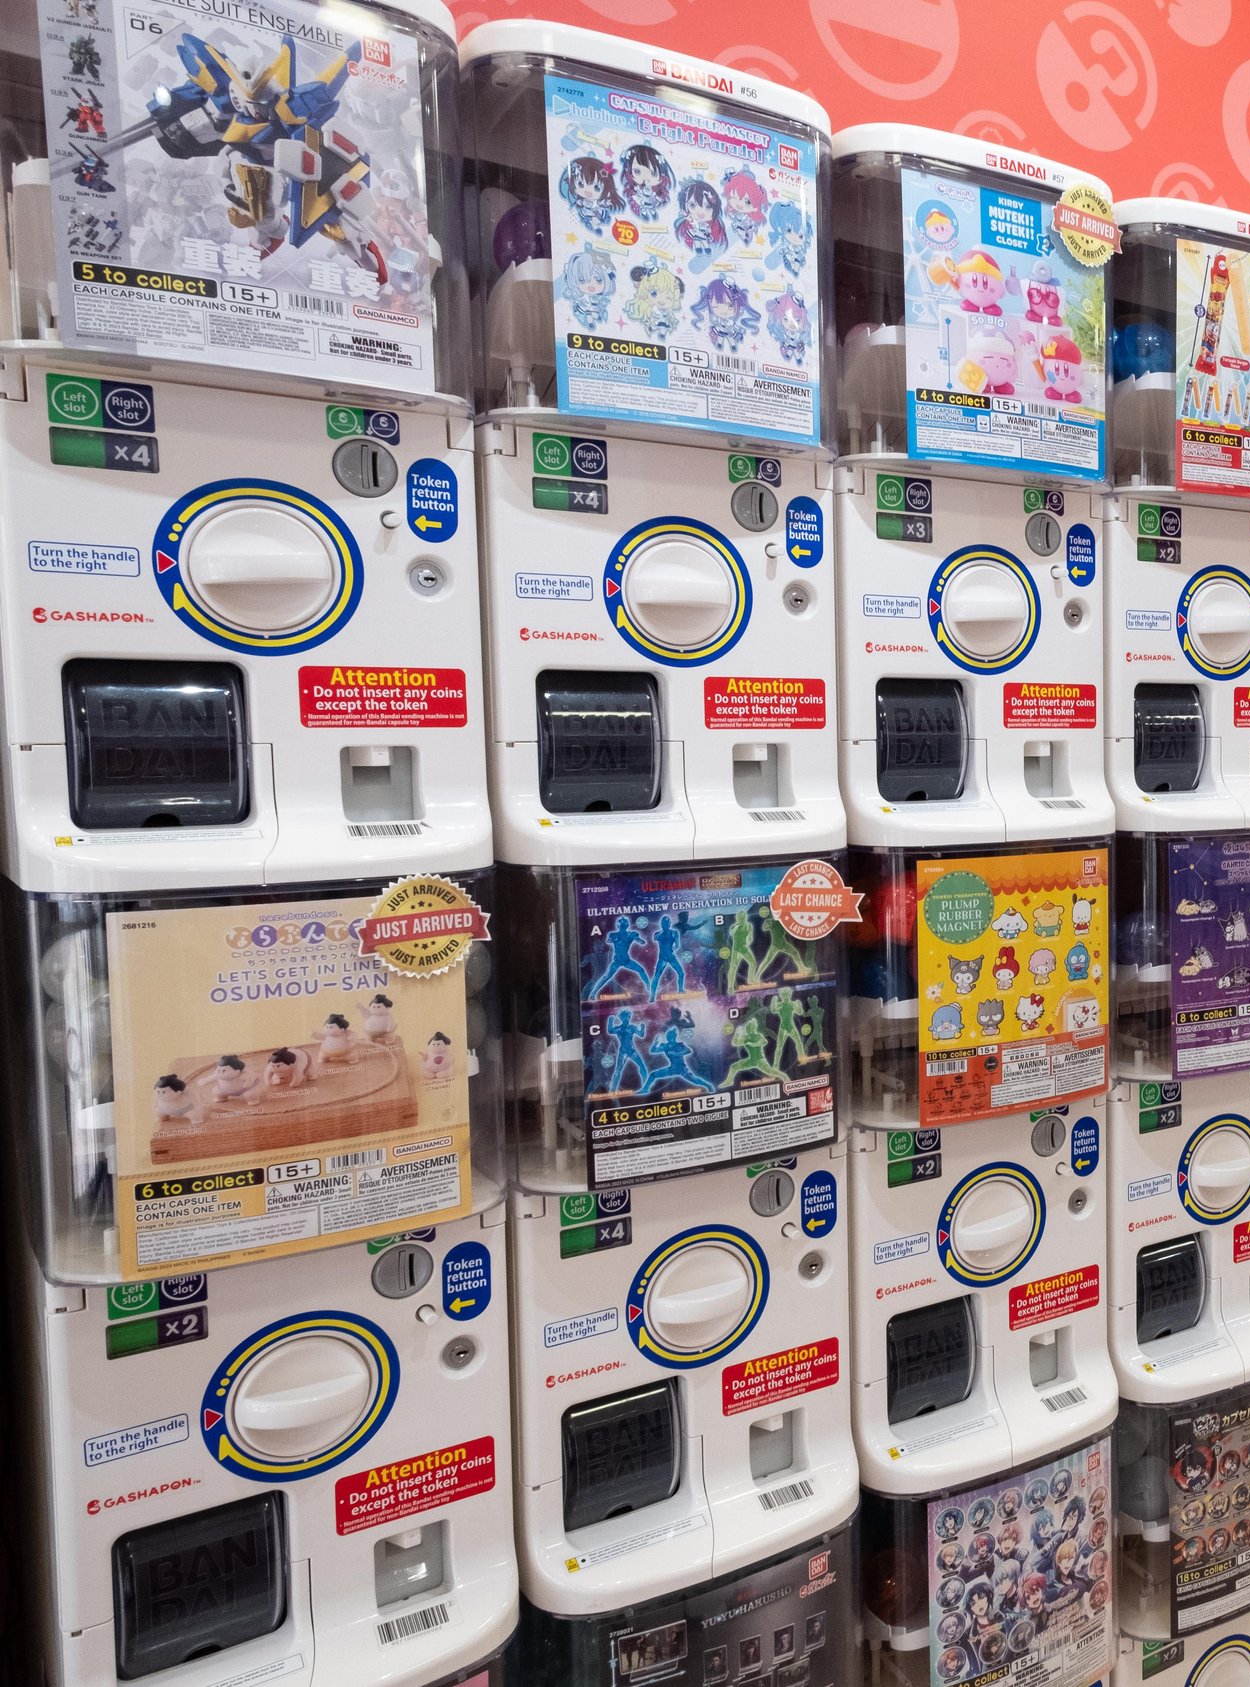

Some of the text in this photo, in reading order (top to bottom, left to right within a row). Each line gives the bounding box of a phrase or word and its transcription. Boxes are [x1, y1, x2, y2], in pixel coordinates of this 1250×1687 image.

[130, 12, 152, 20] PART
[131, 19, 162, 34] 06
[249, 8, 343, 48] ENSEMBLE
[365, 39, 388, 54] BAN
[367, 50, 384, 61] DAI
[361, 66, 405, 86] ガシャポン
[671, 67, 757, 99] BANDAI #56
[572, 103, 625, 126] hololive
[611, 95, 769, 147] CAPSULE RUBBER MASCOT
[638, 116, 694, 144] Bright
[1000, 158, 1064, 183] BANDAI #57
[998, 198, 1025, 209] KIRBY
[989, 206, 1034, 227] MUTEKI!
[1060, 209, 1114, 239] JUST ARRIVED
[991, 220, 1034, 240] SUTEKI!
[996, 236, 1028, 249] CLOSET
[1044, 240, 1050, 250] 2
[82, 265, 205, 295] 5 to collect
[74, 284, 281, 319] EACH CAPSULE CONTAINS ONE ITEM
[230, 287, 270, 303] 15+
[357, 309, 415, 324] BANDAI NAMCO
[971, 314, 1008, 328] So BIG!
[351, 336, 402, 352] WARNING:
[573, 336, 659, 358] 9 to collect
[675, 350, 703, 363] 15+
[690, 369, 733, 383] WARNING:
[753, 380, 811, 397] AVERTISSEMENT:
[63, 390, 86, 403] Left
[920, 390, 985, 407] 4 to collect
[64, 400, 86, 414] slot
[112, 397, 143, 412] Right
[996, 401, 1018, 412] 15+
[118, 408, 139, 421] slot
[412, 474, 449, 488] Token
[412, 488, 450, 500] return
[412, 498, 454, 512] button
[33, 546, 135, 562] Turn the handle
[33, 558, 107, 571] to the right
[330, 667, 436, 686] Attention
[314, 686, 463, 700] Do not insert any coins
[727, 679, 803, 694] Attention
[316, 699, 428, 712] except the token
[780, 893, 842, 906] LAST CHANCE
[942, 900, 979, 910] PLUMP
[587, 906, 644, 916] ULTRAMAN
[648, 904, 668, 912] NEW
[673, 899, 732, 910] GENERATION
[939, 910, 982, 921] RUBBER
[373, 913, 473, 940] JUST ARRIVED
[937, 920, 985, 932] MAGNET
[226, 919, 364, 949] ならぶんで
[218, 960, 382, 983] LET'S GET IN LINE
[210, 972, 389, 1003] OSUMOU-SAN
[1180, 1008, 1232, 1022] 8 to collect
[950, 1049, 975, 1059] collect
[698, 1096, 727, 1109] 15+
[599, 1102, 682, 1123] 4 to collect
[275, 1164, 314, 1179] 15+
[380, 1155, 458, 1178] AVERTISSEMENT:
[142, 1172, 254, 1198] 6 to collect
[294, 1176, 352, 1193] WARNING:
[366, 1446, 466, 1489] Attention
[1179, 1561, 1232, 1583] 18 to collect
